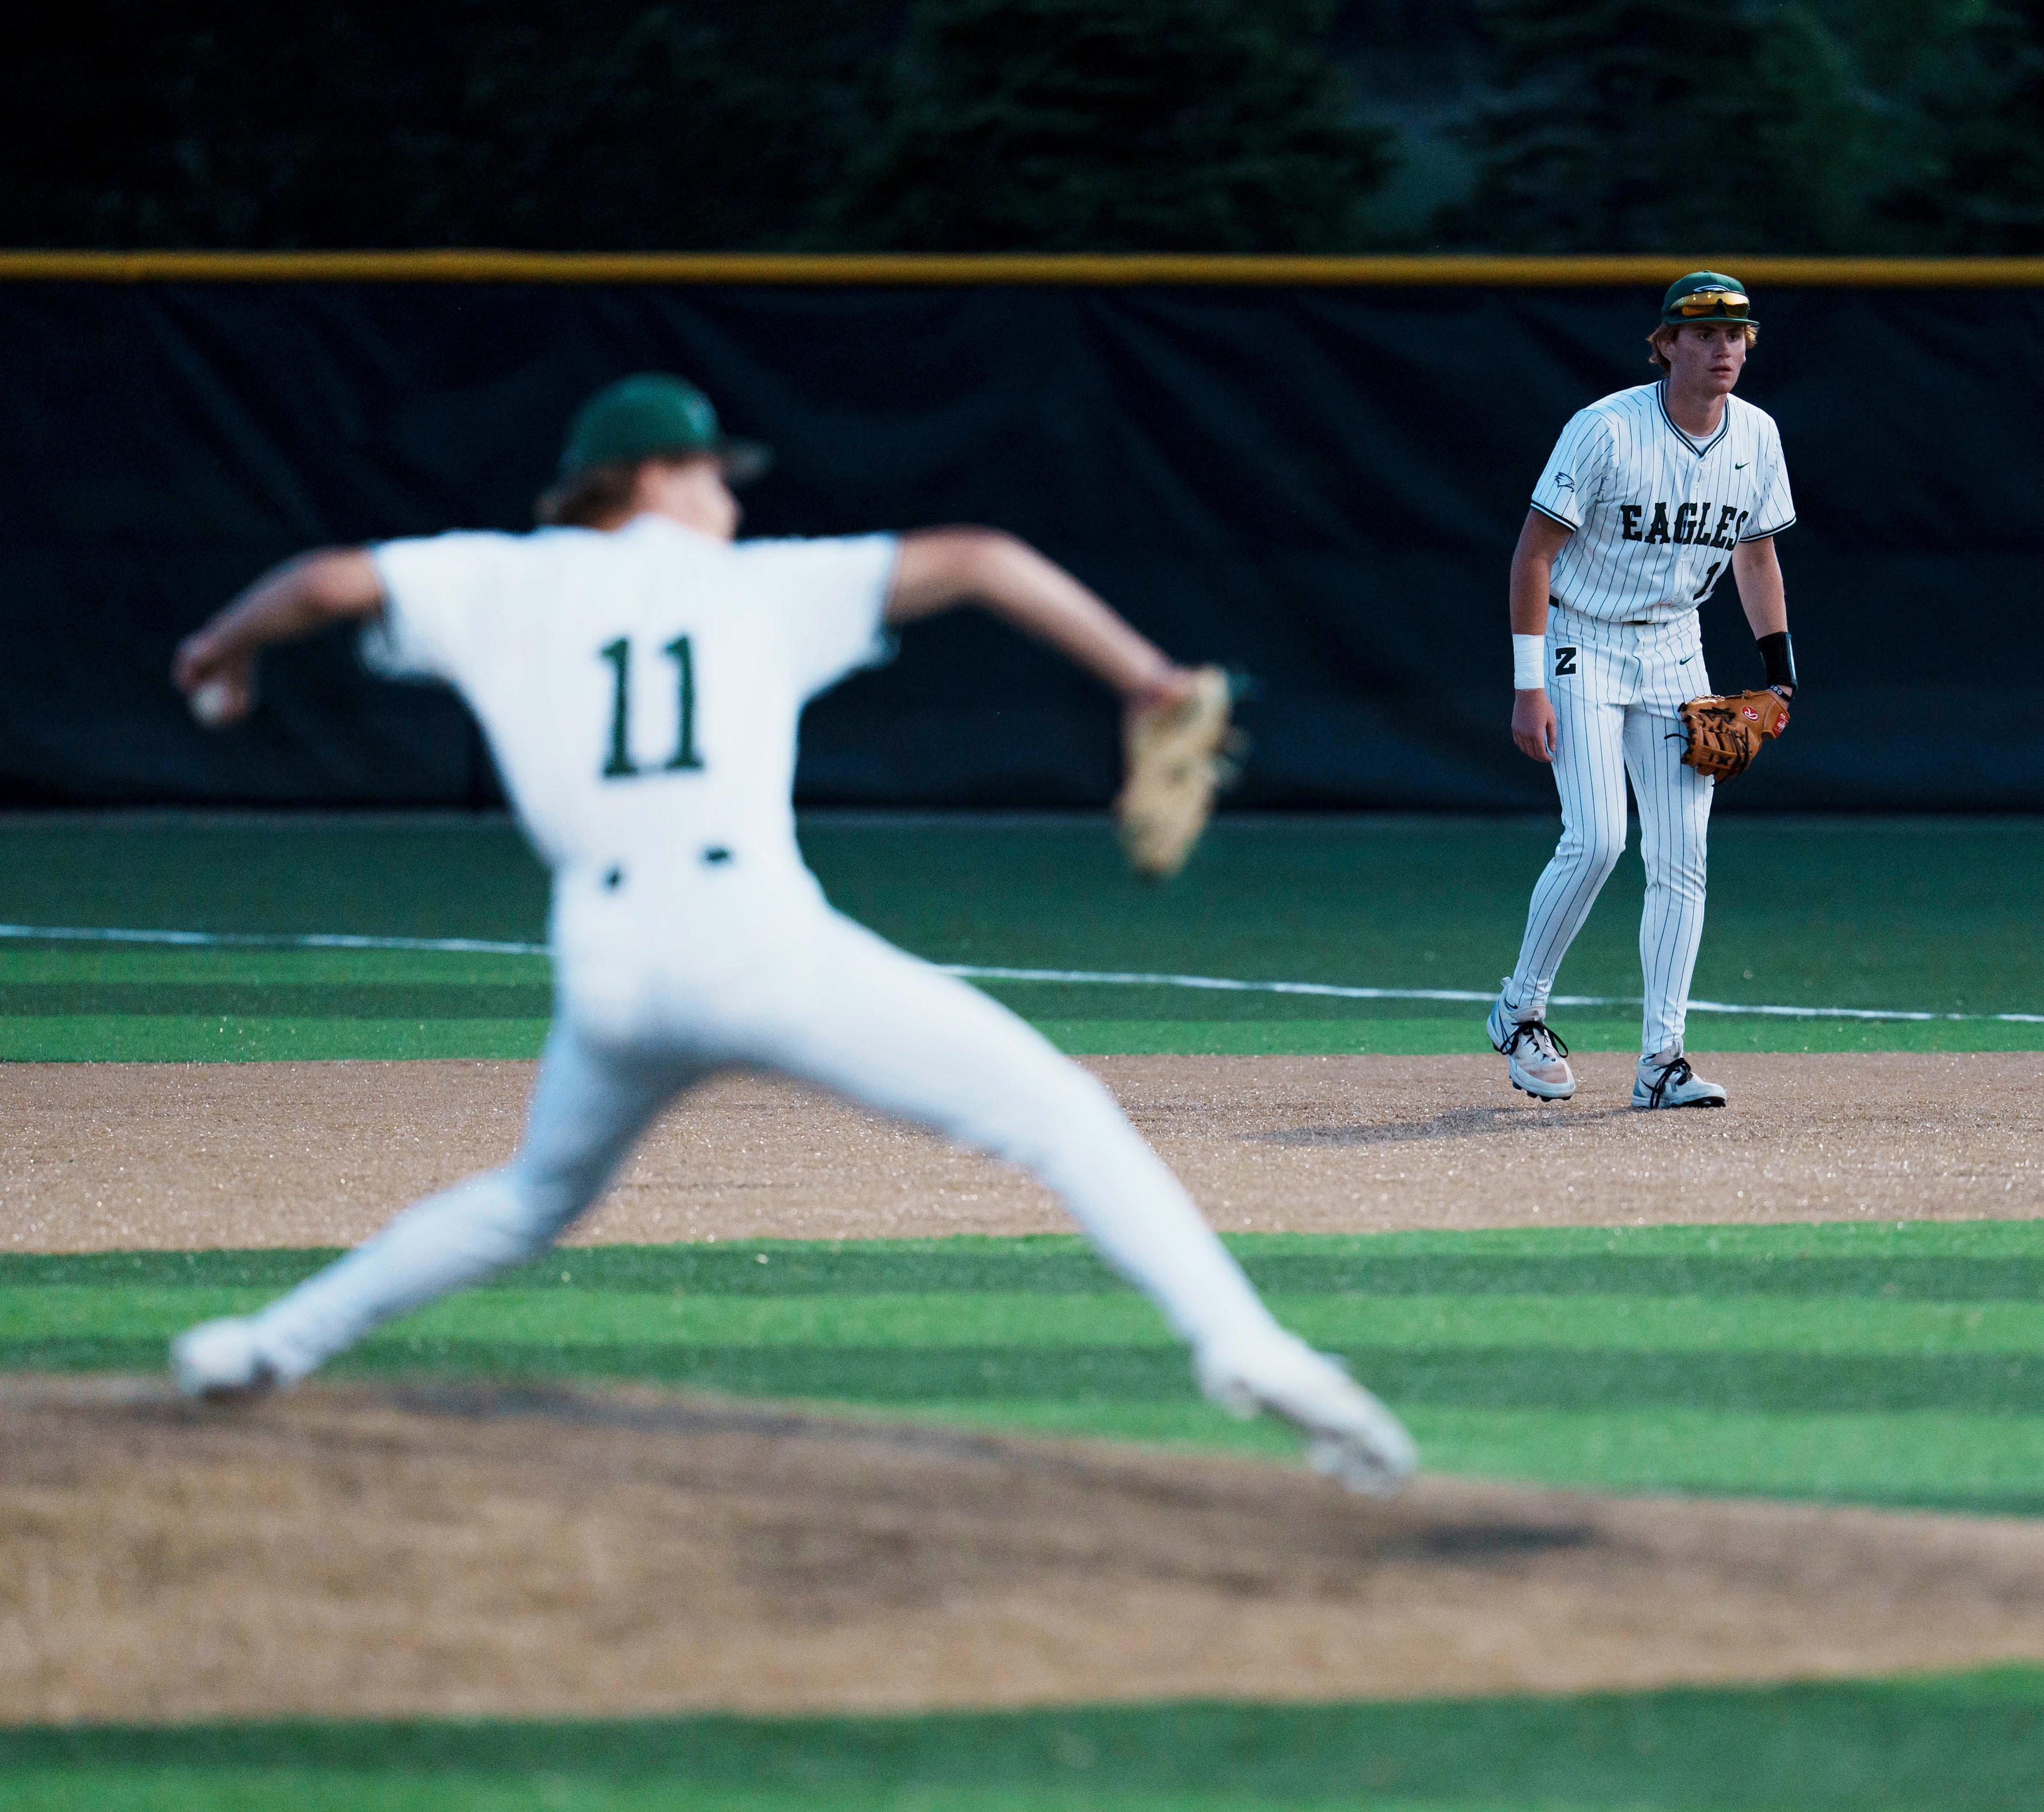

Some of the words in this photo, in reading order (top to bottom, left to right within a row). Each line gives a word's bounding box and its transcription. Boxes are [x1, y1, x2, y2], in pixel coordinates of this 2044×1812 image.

[1621, 502, 1749, 551] EAGLES
[1555, 647, 1576, 676] Z
[597, 633, 705, 779] 11
